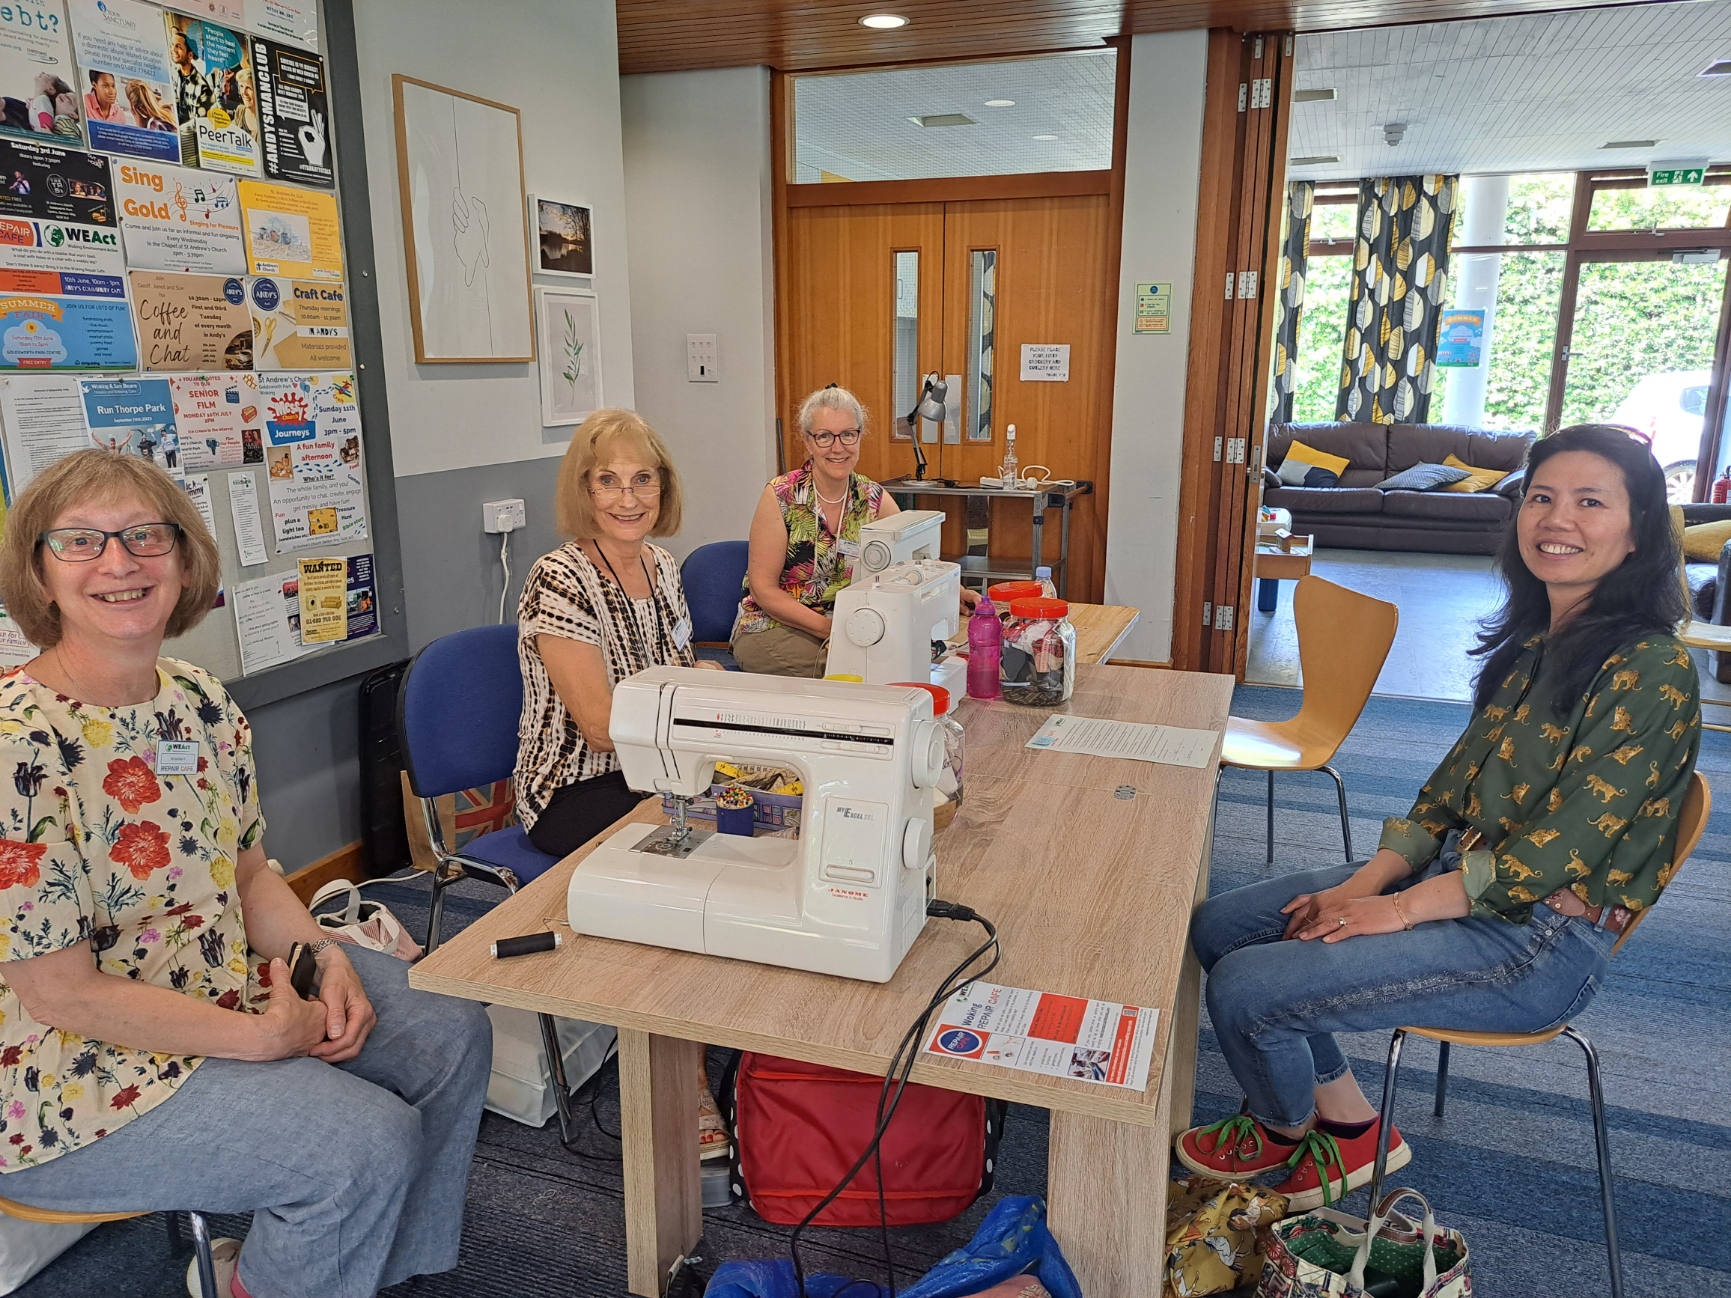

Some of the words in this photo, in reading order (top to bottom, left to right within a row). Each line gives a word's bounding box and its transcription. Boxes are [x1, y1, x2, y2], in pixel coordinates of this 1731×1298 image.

[103, 13, 136, 28] SANCTUARY
[117, 41, 127, 50] help
[206, 34, 218, 42] start
[225, 39, 236, 47] heal
[86, 42, 108, 52] domestic
[216, 44, 236, 54] moment
[102, 53, 112, 61] ring
[208, 48, 218, 56] they
[220, 50, 229, 58] feel
[93, 59, 112, 67] number
[255, 43, 279, 175] #ANDYSMANCLUB
[199, 125, 253, 149] PeerTalk
[10, 142, 40, 154] Saturday
[120, 165, 164, 192] Sing
[124, 198, 172, 221] Gold
[190, 220, 208, 228] Singing
[65, 227, 117, 246] WEAct
[180, 236, 208, 245] Wednesday
[220, 232, 240, 240] singalong
[161, 242, 178, 250] Chapel
[190, 244, 210, 252] Andrew's
[64, 276, 76, 284] 10th
[256, 290, 278, 300] ANDY'S
[294, 287, 319, 300] Craft
[320, 290, 344, 302] Cafe
[0, 299, 56, 312] SUMMER
[299, 304, 320, 312] Thursday
[14, 311, 44, 320] FAIR
[140, 299, 188, 326] Coffee
[153, 322, 182, 344] and
[150, 344, 190, 365] Chat
[188, 390, 220, 398] SENIOR
[97, 405, 114, 414] Run
[114, 404, 144, 415] Thorpe
[145, 403, 166, 412] Park
[196, 401, 216, 409] FILM
[318, 406, 342, 414] Sunday
[332, 416, 346, 424] June
[274, 429, 310, 438] Journeys
[324, 428, 338, 436] 3pm
[302, 442, 314, 450] fun
[314, 441, 335, 449] family
[302, 453, 333, 462] afternoon
[312, 484, 329, 492] family,
[282, 494, 310, 504] opportunity
[345, 488, 362, 496] engage
[292, 504, 301, 512] get
[304, 562, 342, 574] WANTED
[828, 888, 869, 898] JANOME
[962, 1002, 983, 1026] Woking
[976, 1005, 994, 1030] REPAIR
[988, 988, 1002, 1005] CAFE
[948, 1031, 964, 1050] REPAIR
[956, 1036, 970, 1049] CAFE
